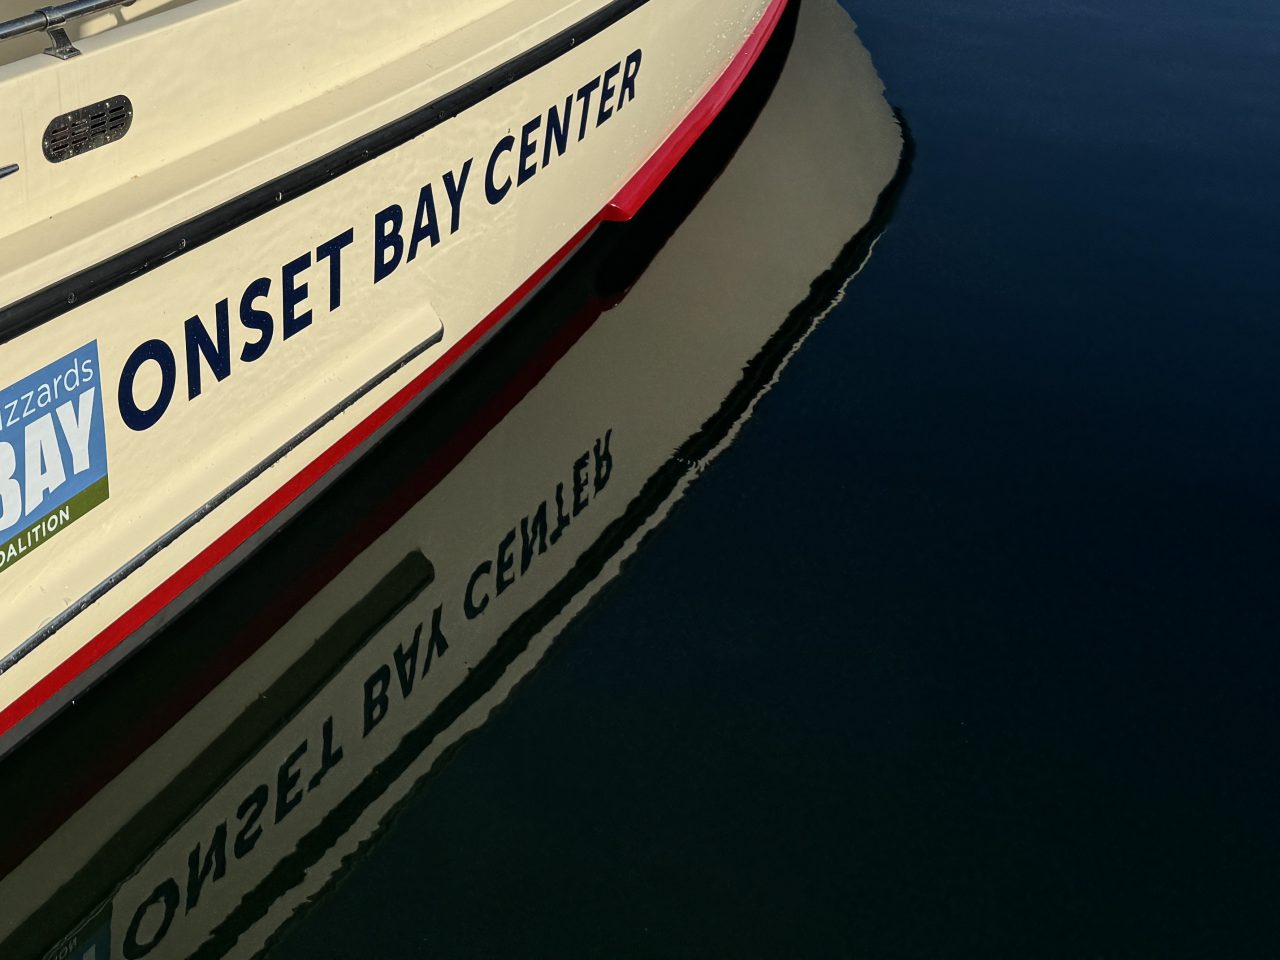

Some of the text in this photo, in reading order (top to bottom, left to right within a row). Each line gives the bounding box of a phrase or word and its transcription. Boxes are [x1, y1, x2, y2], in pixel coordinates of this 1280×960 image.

[117, 48, 643, 432] ONSET BAY CENTER
